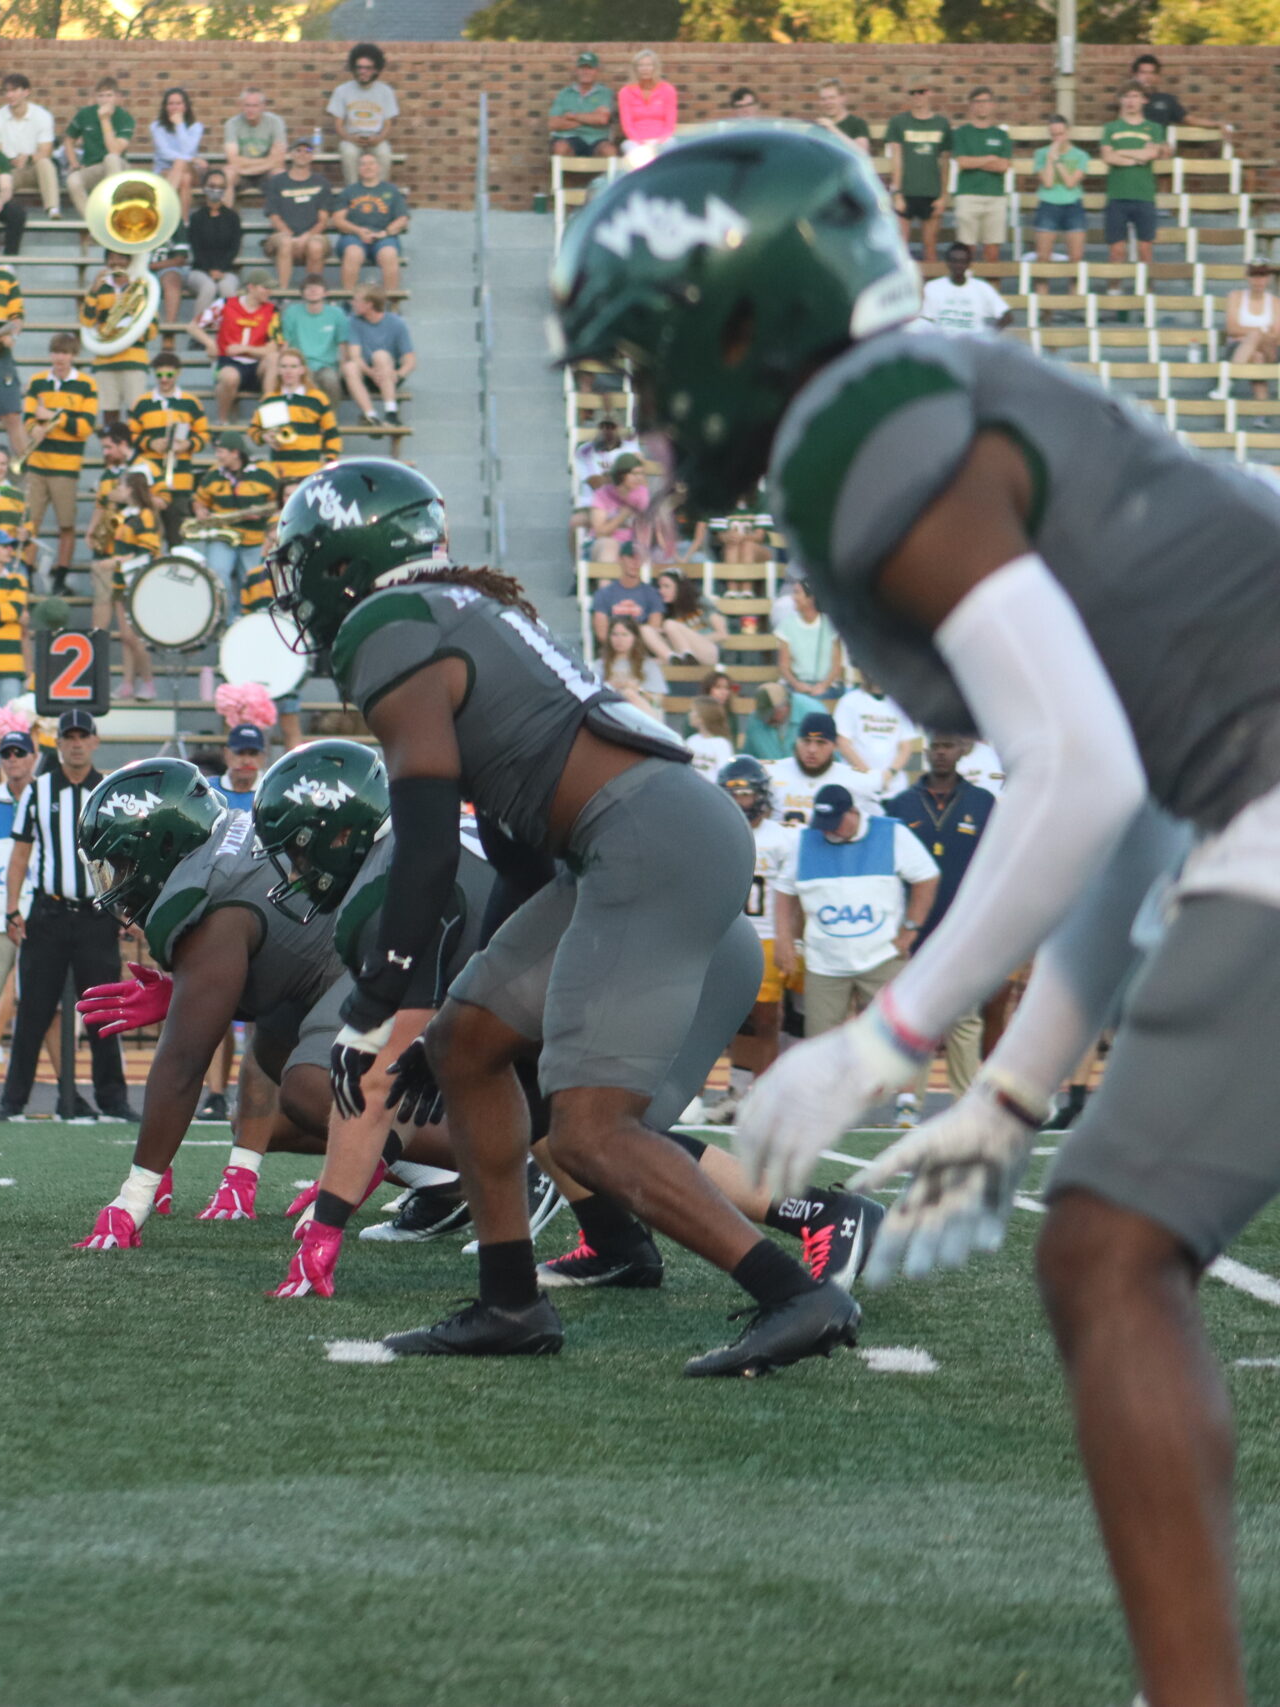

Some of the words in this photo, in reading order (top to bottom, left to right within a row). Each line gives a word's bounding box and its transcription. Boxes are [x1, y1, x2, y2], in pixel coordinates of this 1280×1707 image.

[49, 631, 95, 700] 2
[100, 789, 163, 818] W&M
[283, 774, 357, 812] W&M
[817, 903, 874, 926] CAA
